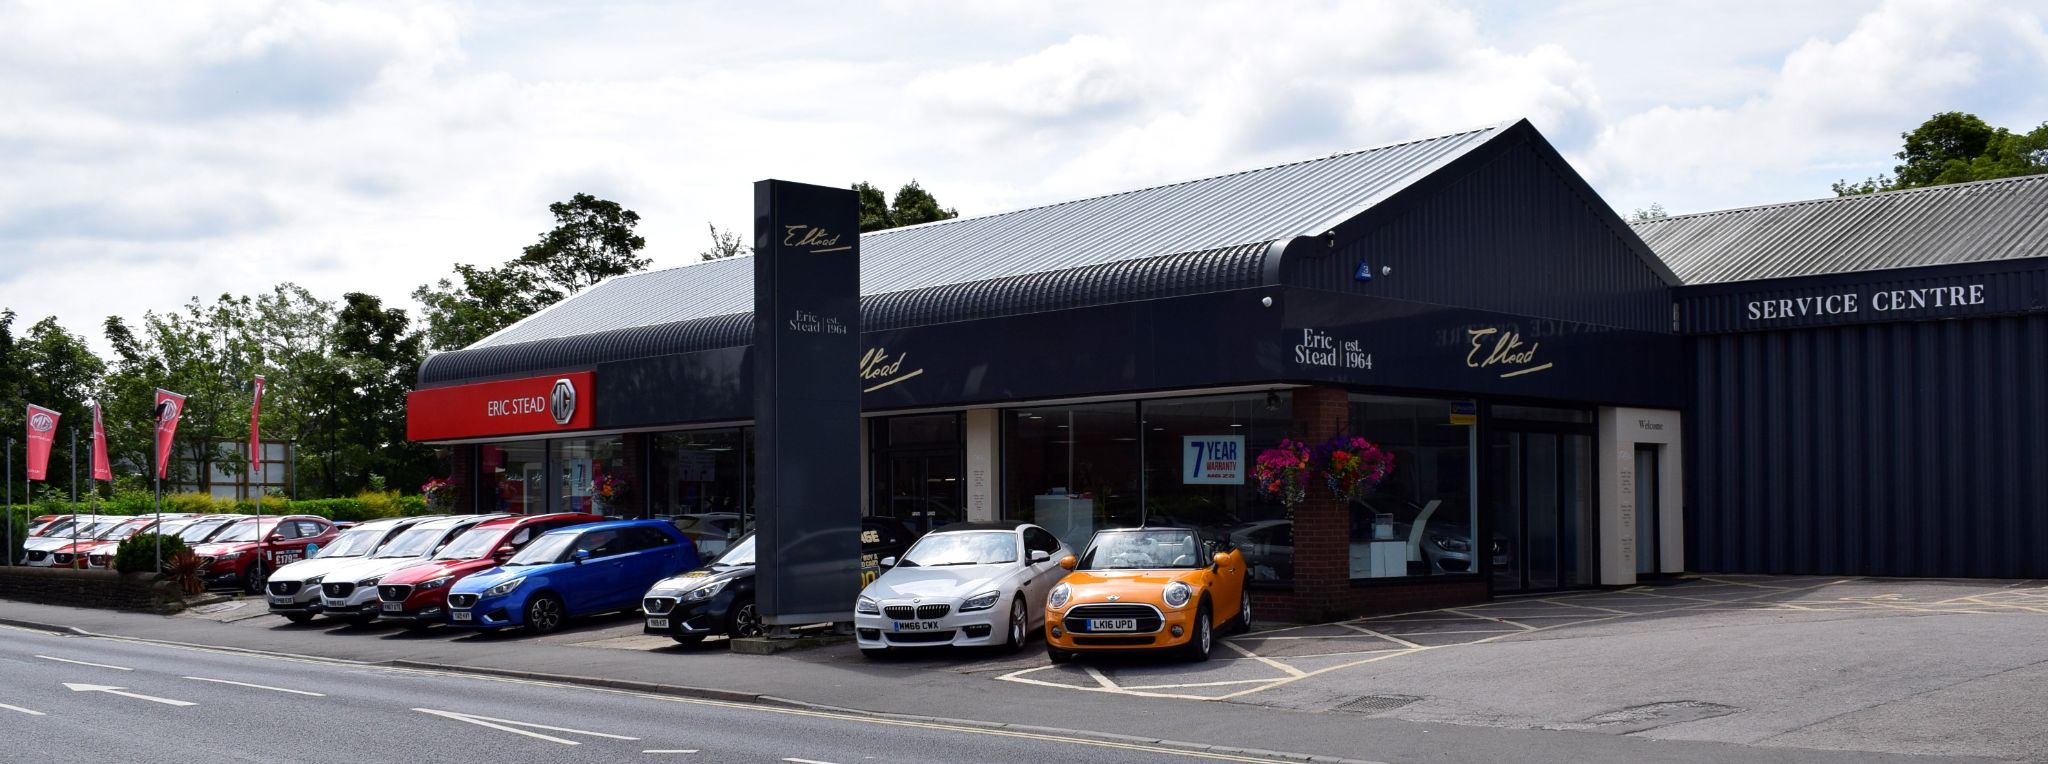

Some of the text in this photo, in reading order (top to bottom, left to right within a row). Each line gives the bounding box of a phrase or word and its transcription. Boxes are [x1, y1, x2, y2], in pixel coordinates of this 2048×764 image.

[1747, 284, 1985, 320] SERVICE CENTRE
[796, 310, 817, 322] Eric
[790, 320, 820, 332] Stead
[1303, 328, 1333, 349] Eric
[1344, 340, 1362, 352] est.
[1295, 344, 1336, 366] Stead
[1345, 351, 1372, 370] 1964
[488, 382, 573, 421] ERIC STEAD MG
[31, 414, 53, 431] MG
[1638, 419, 1664, 430] Welcome
[1191, 441, 1237, 478] 7 YEAR
[1206, 461, 1236, 471] WARRANTY
[899, 621, 939, 630] MM66 CWX
[1093, 619, 1133, 629] LK16 UPD
